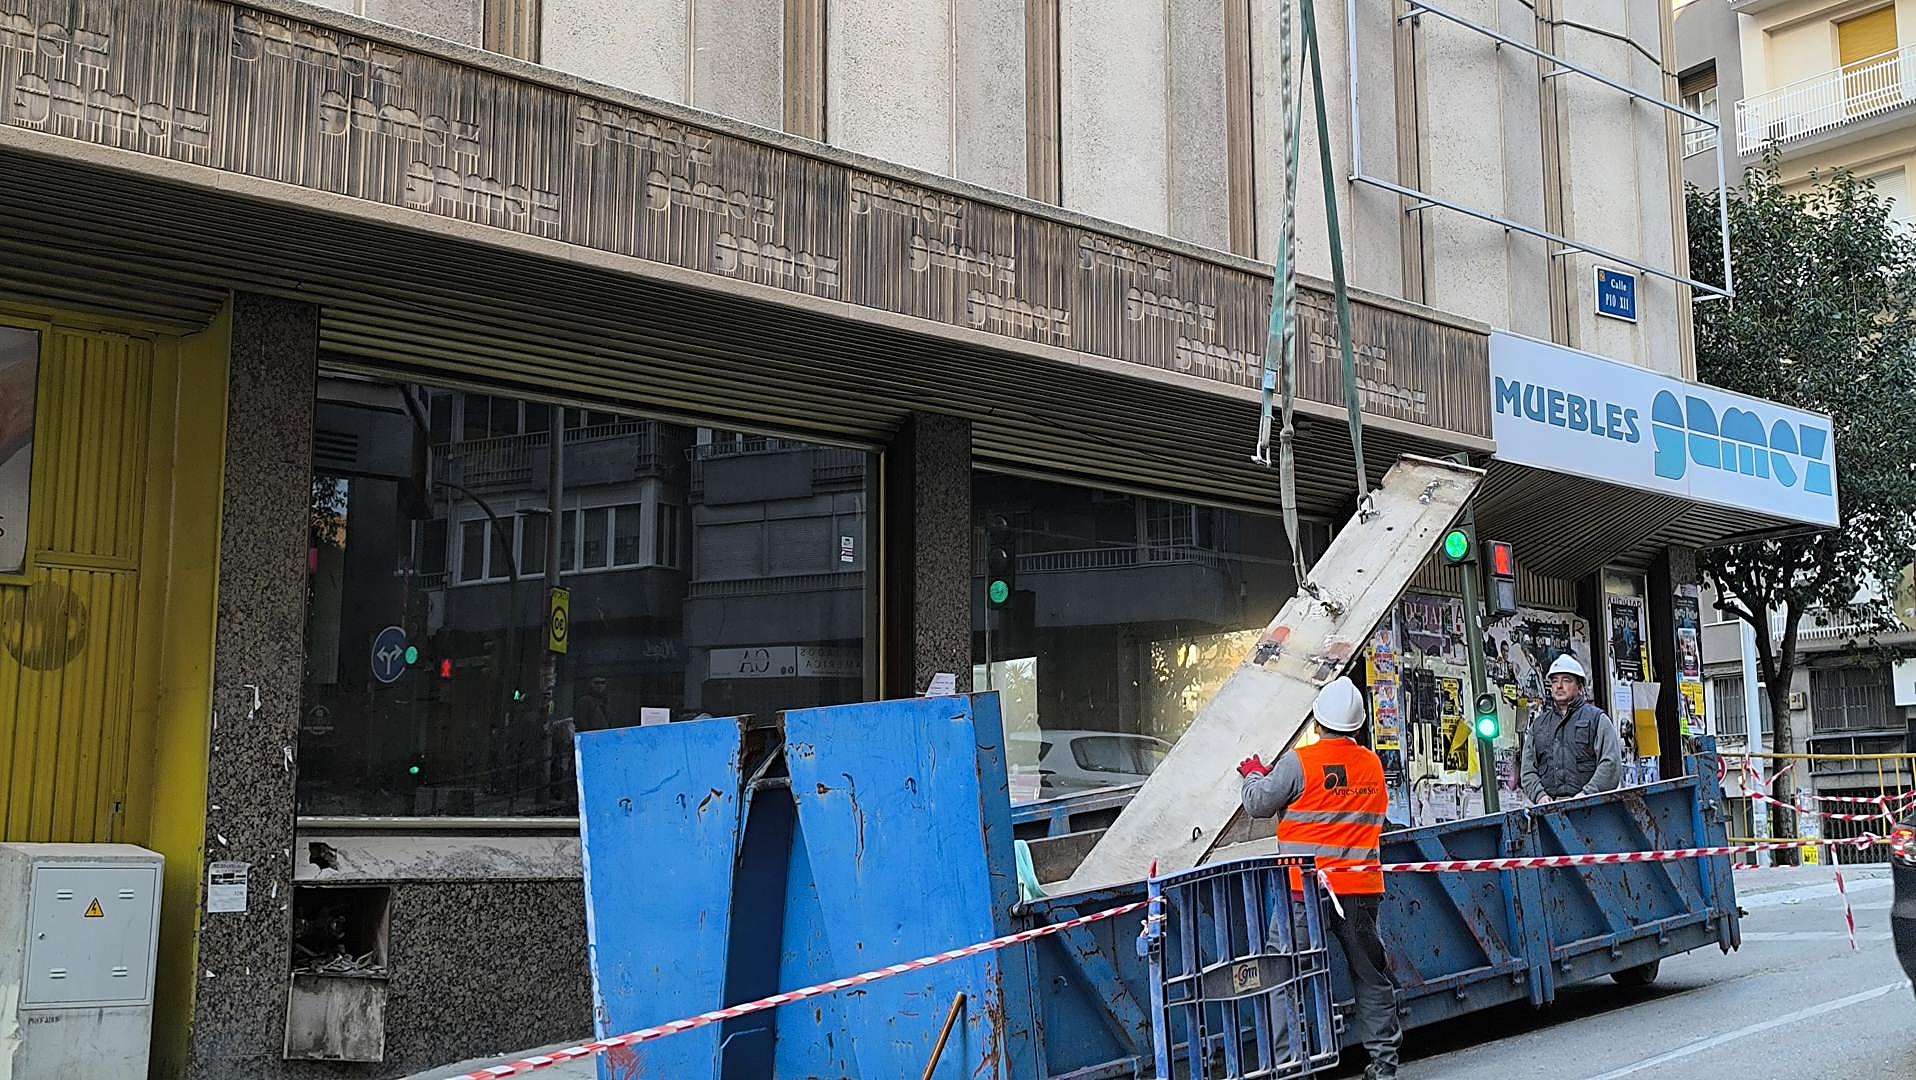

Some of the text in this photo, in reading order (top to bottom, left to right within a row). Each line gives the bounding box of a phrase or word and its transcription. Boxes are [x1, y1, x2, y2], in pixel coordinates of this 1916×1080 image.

[1610, 278, 1627, 292] Calle
[1605, 292, 1629, 311] PIO XII
[1494, 376, 1641, 444] MUEBLES
